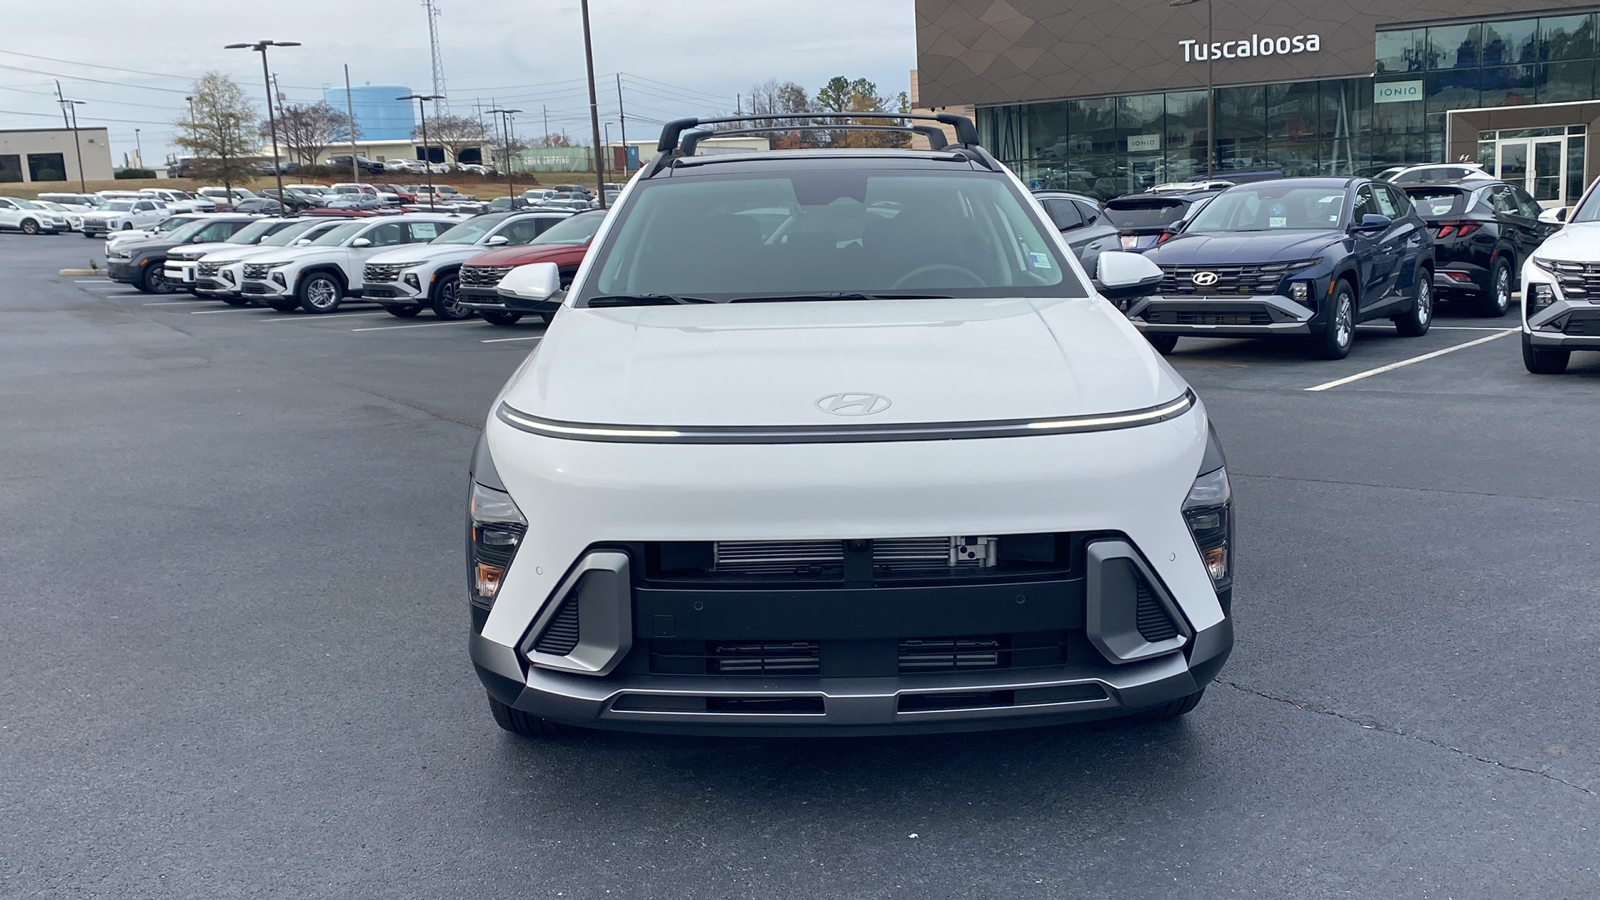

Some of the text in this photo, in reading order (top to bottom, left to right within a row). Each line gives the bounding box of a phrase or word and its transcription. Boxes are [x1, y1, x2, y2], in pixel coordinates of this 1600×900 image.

[1178, 33, 1320, 62] Tuscaloosa
[1379, 86, 1417, 97] IONIQ
[523, 156, 541, 166] CHINA
[543, 155, 570, 165] SHIPPING
